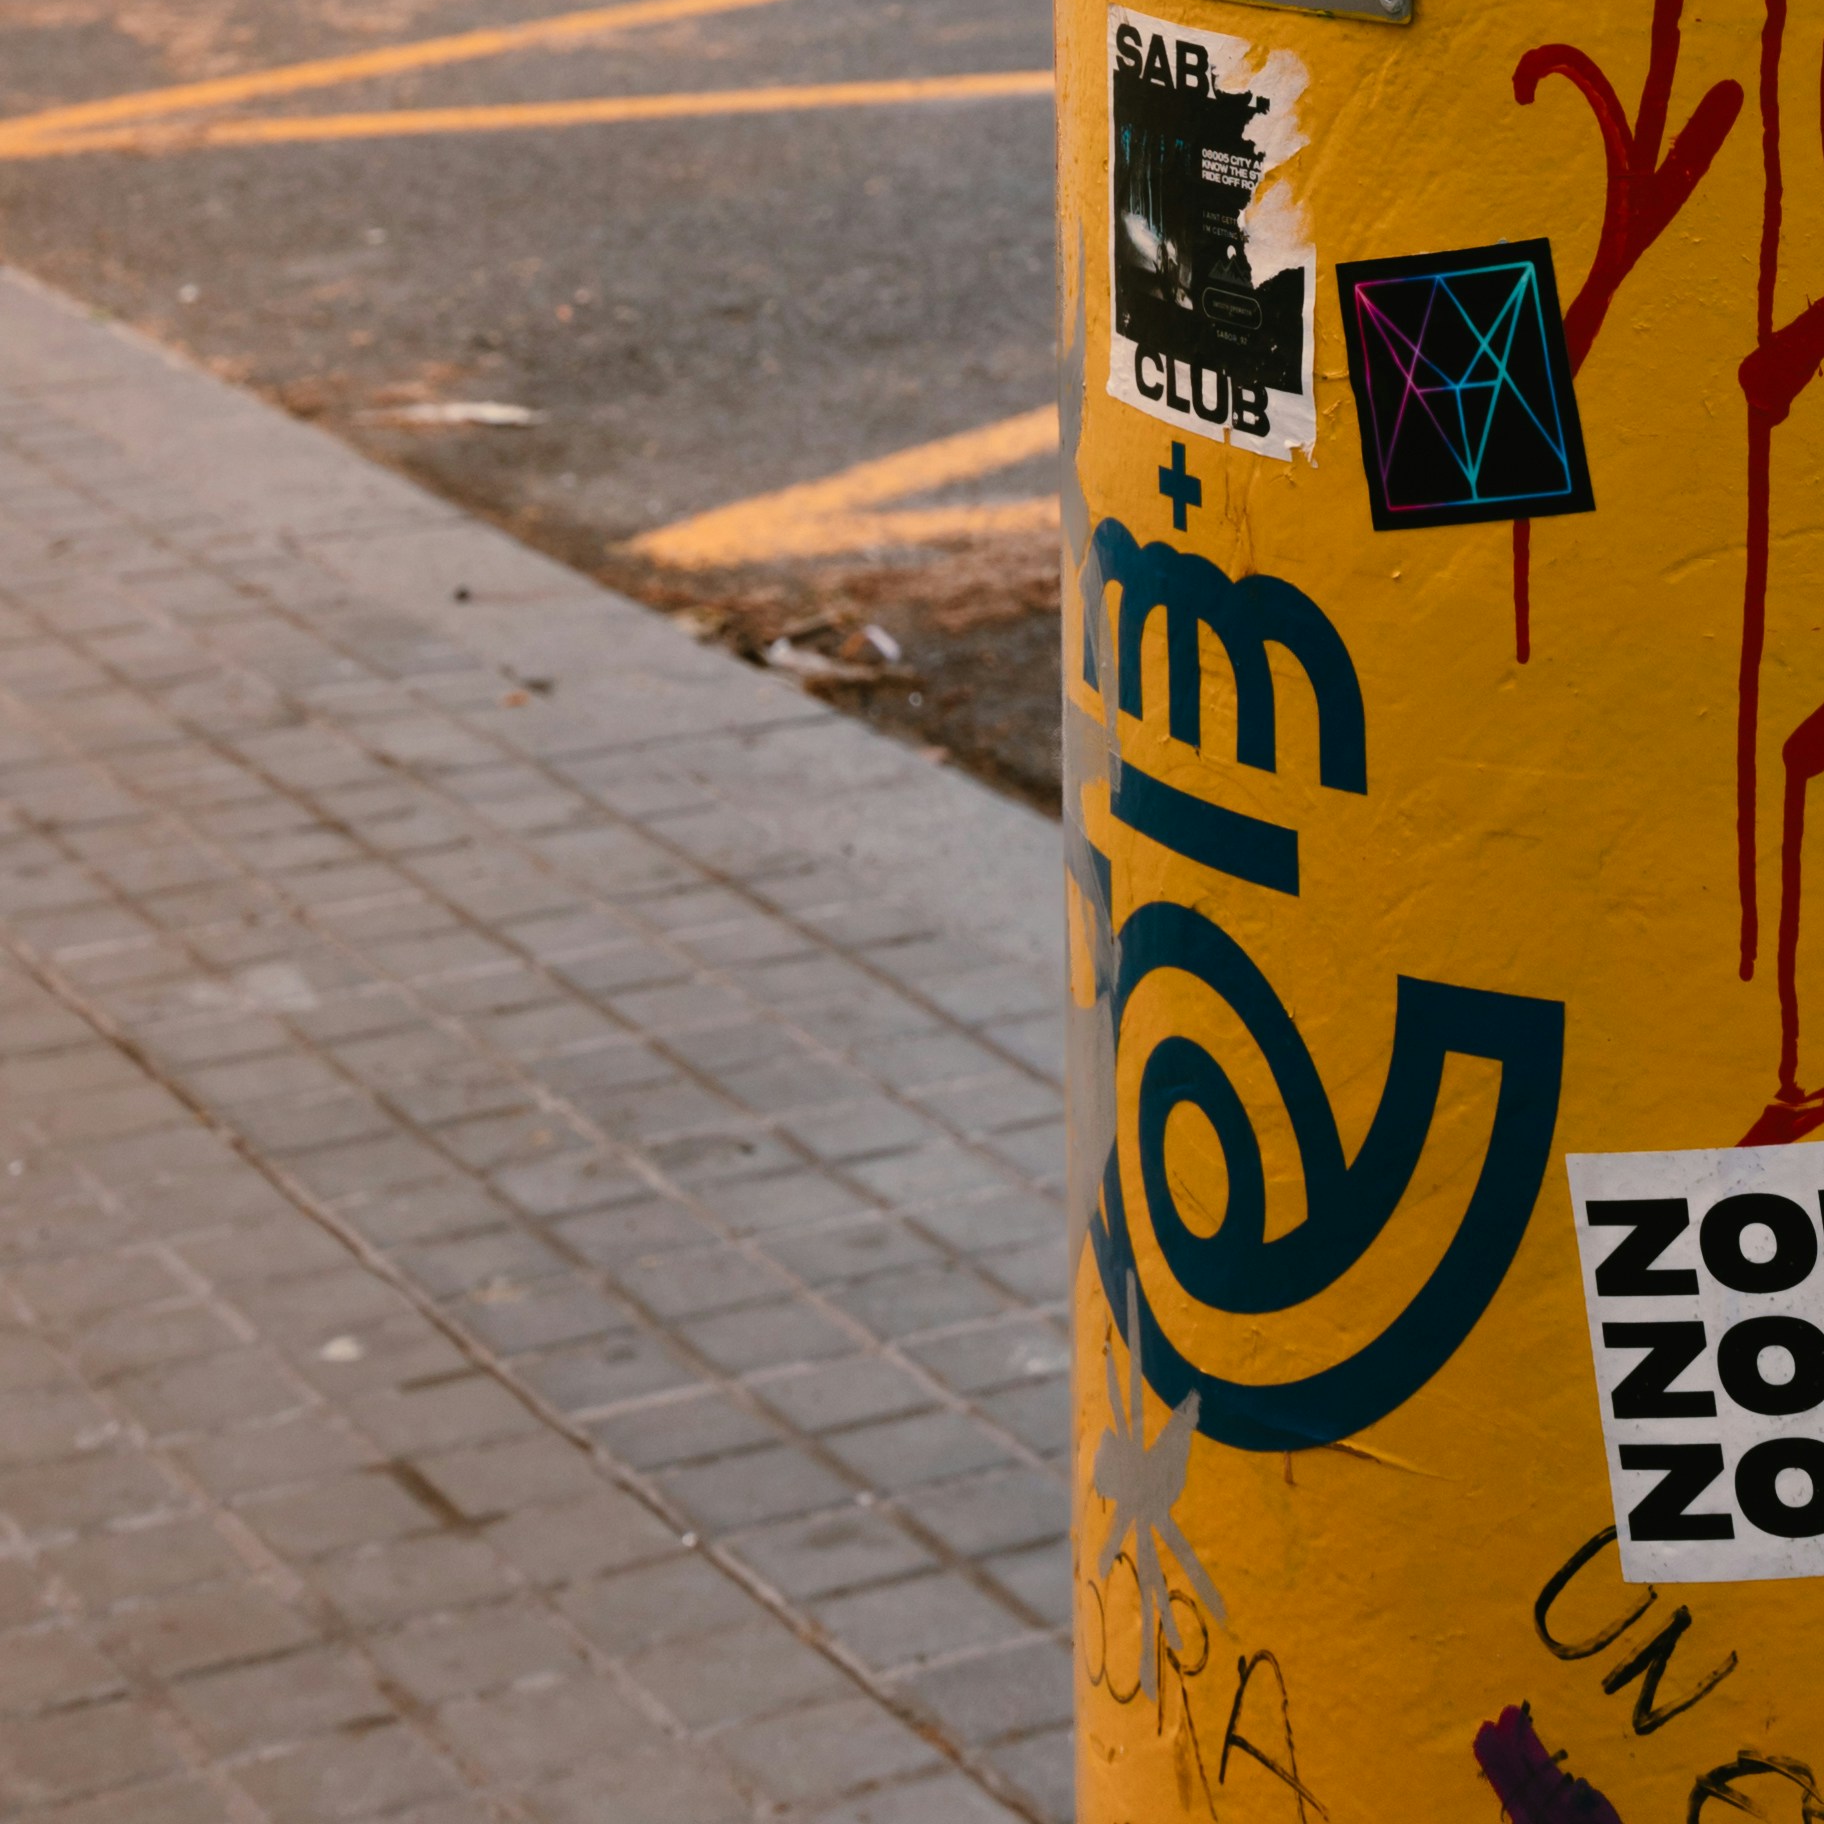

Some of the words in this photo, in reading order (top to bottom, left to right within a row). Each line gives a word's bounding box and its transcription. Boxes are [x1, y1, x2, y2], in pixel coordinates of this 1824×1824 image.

[1201, 159, 1228, 174] KNOW
[1230, 166, 1248, 179] THE
[1230, 155, 1252, 168] CITY
[1201, 169, 1221, 184] RIDE
[1222, 175, 1240, 188] OFF
[1135, 342, 1271, 438] CLUB
